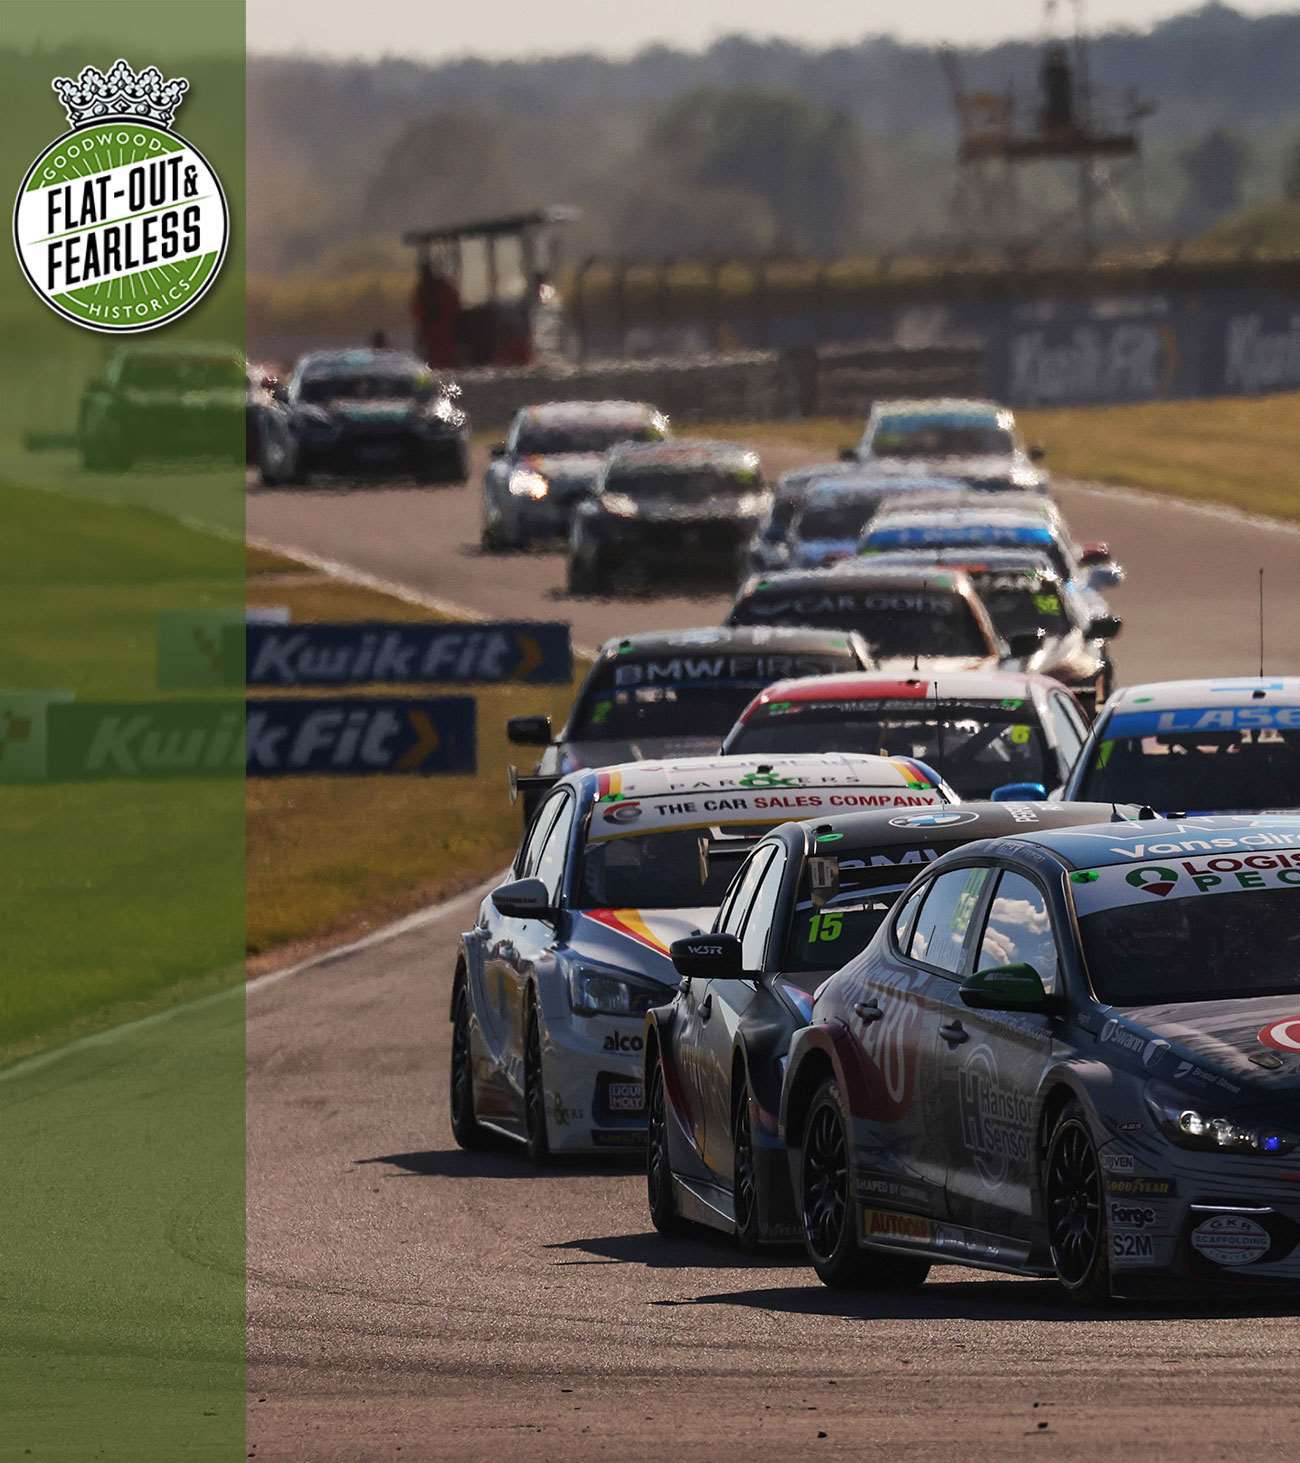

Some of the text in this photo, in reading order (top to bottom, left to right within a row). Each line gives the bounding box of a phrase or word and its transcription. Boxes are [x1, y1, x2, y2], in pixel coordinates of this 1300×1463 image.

[654, 795, 936, 816] THE CAR SALES COMPANY
[808, 912, 846, 944] 15
[603, 1030, 643, 1051] alco
[1111, 1203, 1155, 1228] Forge
[1113, 1235, 1153, 1257] S2M
[1195, 1235, 1268, 1247] SCAFFOLDING
